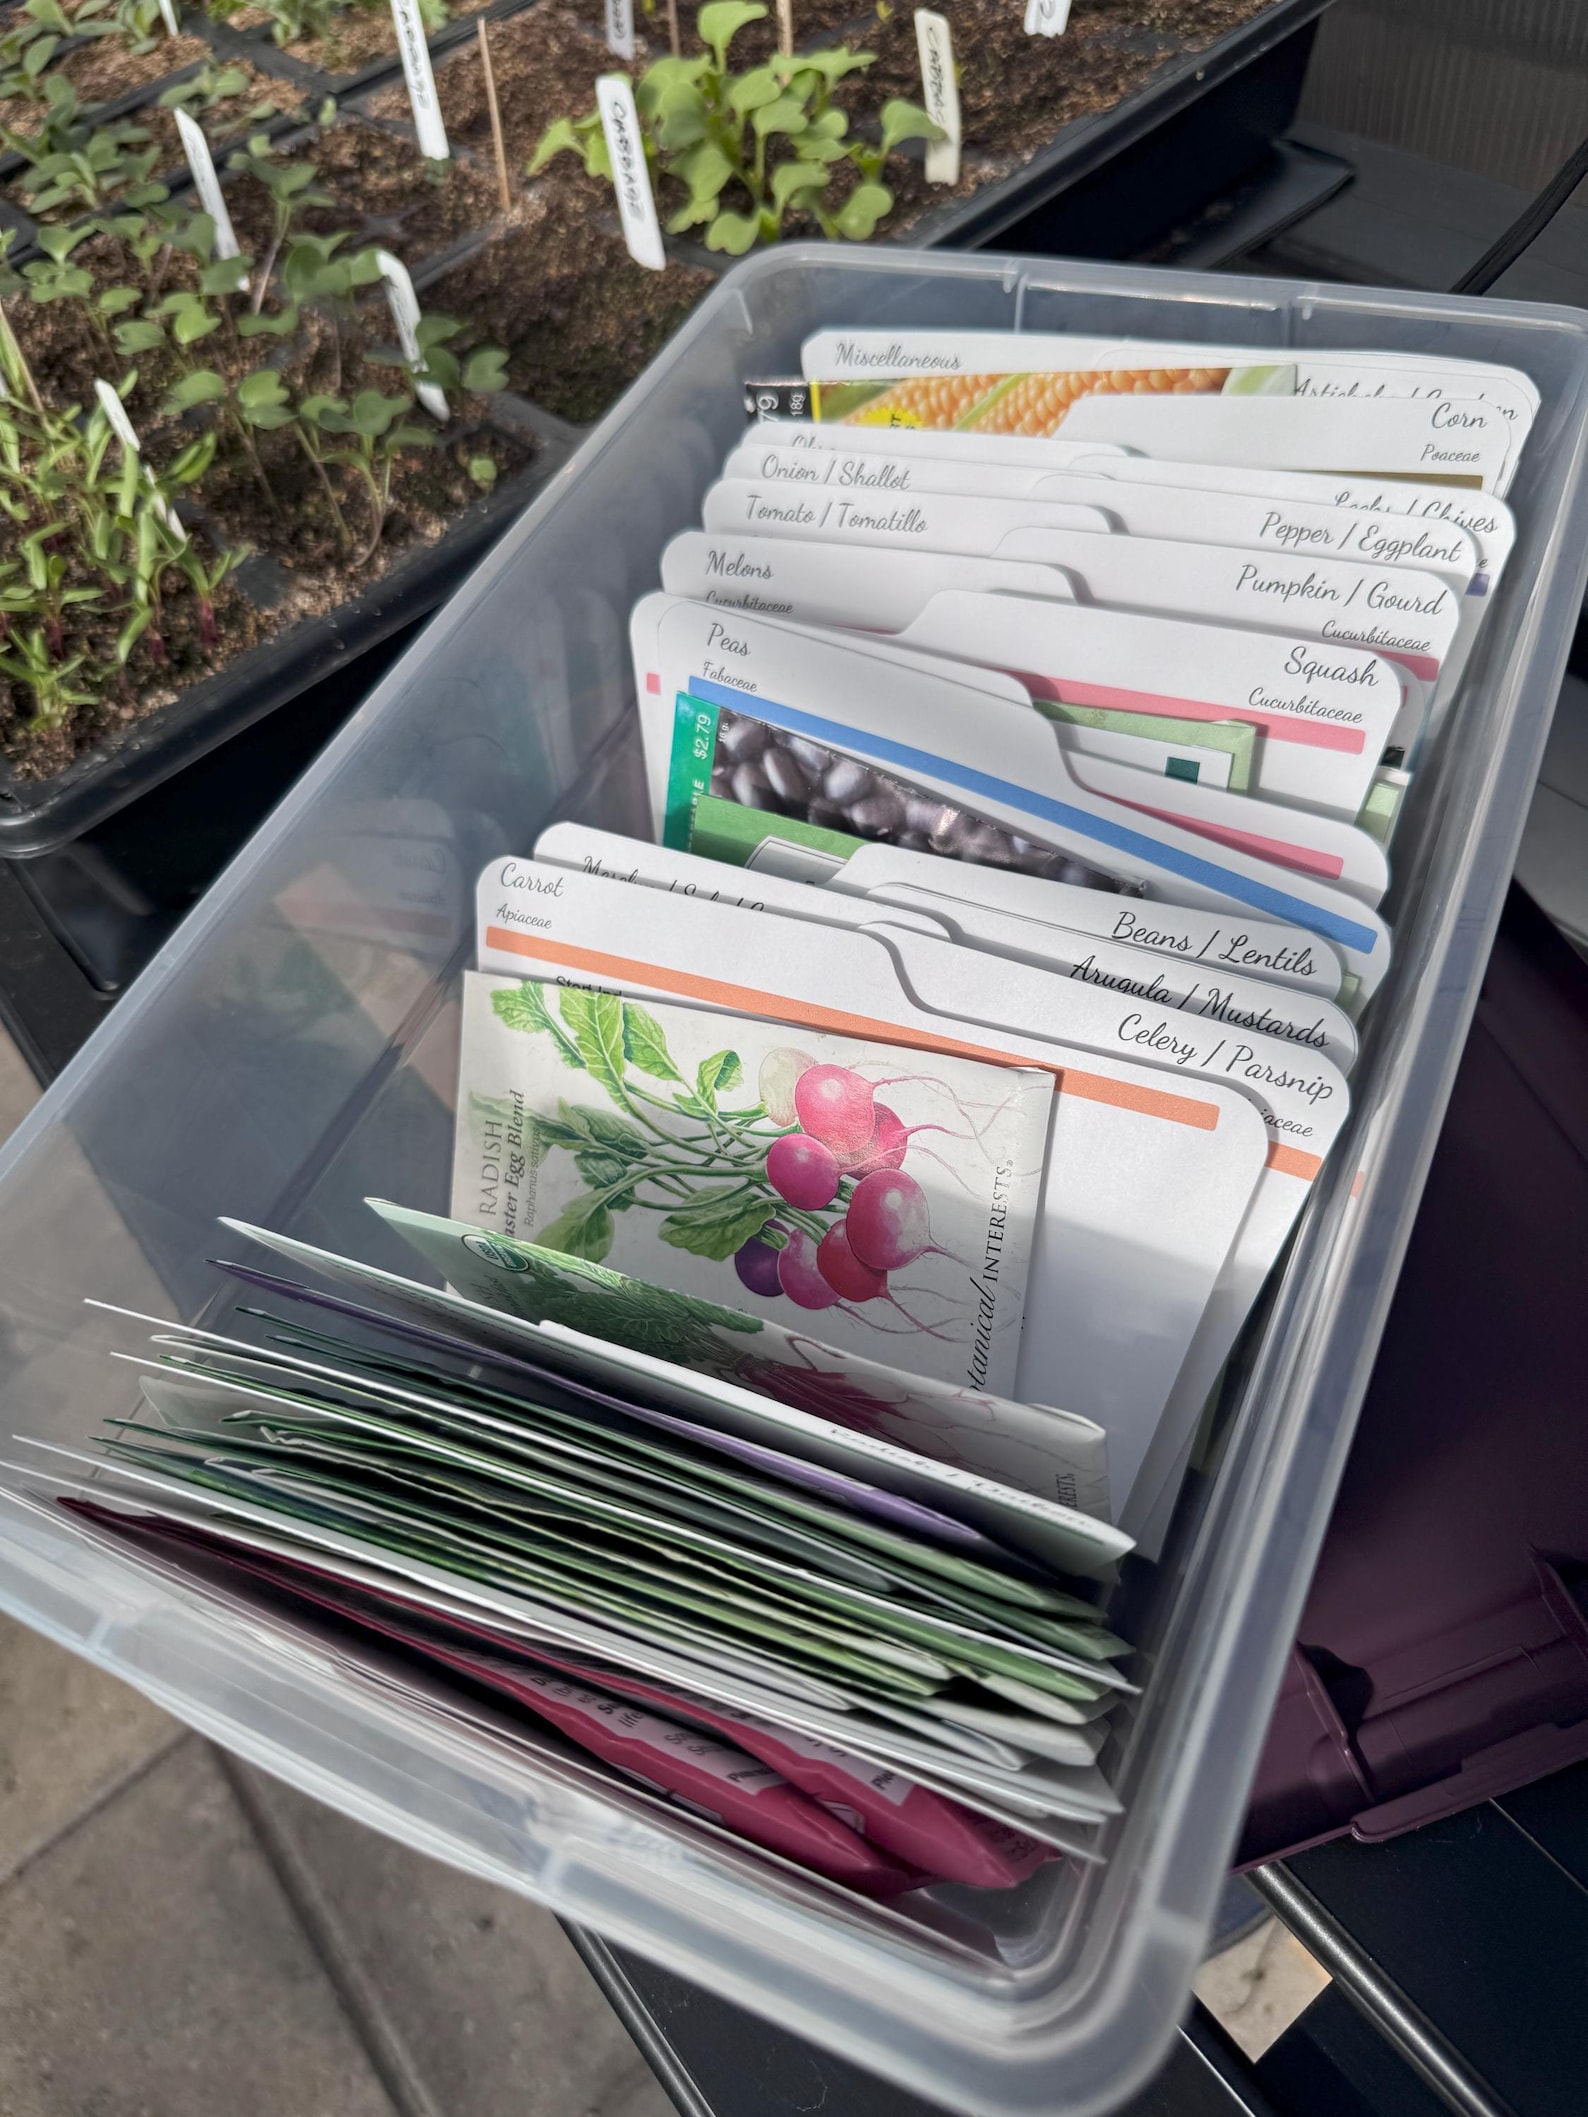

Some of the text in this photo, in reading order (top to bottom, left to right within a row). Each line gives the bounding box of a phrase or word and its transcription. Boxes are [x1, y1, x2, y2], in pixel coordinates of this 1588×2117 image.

[835, 341, 962, 371] Miscellaneous
[1431, 402, 1488, 429] Corn
[761, 454, 820, 482] Onion
[838, 460, 912, 490] Shallot
[1419, 442, 1482, 463] Poaceae
[745, 494, 816, 524] Tomato
[837, 502, 928, 534] Tomatillo
[1258, 511, 1334, 549] Pepper
[1358, 524, 1463, 562] Eggplant
[705, 549, 775, 580] Melons
[1235, 563, 1341, 604] Pumpkin
[1366, 581, 1449, 615] Gourd
[706, 622, 751, 657] Peas
[1321, 619, 1431, 652] Cucurbitaceae
[702, 660, 758, 693] Fabaceae
[1284, 645, 1380, 687] Squash
[1248, 686, 1363, 724] Cucurbitaceae
[693, 714, 712, 760] $2.79
[499, 862, 565, 898] Carrot
[495, 902, 553, 930] Apiaceae
[1111, 911, 1193, 952] Beans
[1218, 934, 1318, 977] Lentils
[1198, 988, 1330, 1048] Mustards
[1117, 1013, 1198, 1065] Celery
[1225, 1044, 1334, 1106] Parsnip
[507, 1088, 525, 1149] Blend
[479, 1119, 503, 1216] RADISH
[504, 1151, 526, 1188] Egg
[504, 1192, 519, 1238] aster
[524, 1168, 539, 1228] Raphanus
